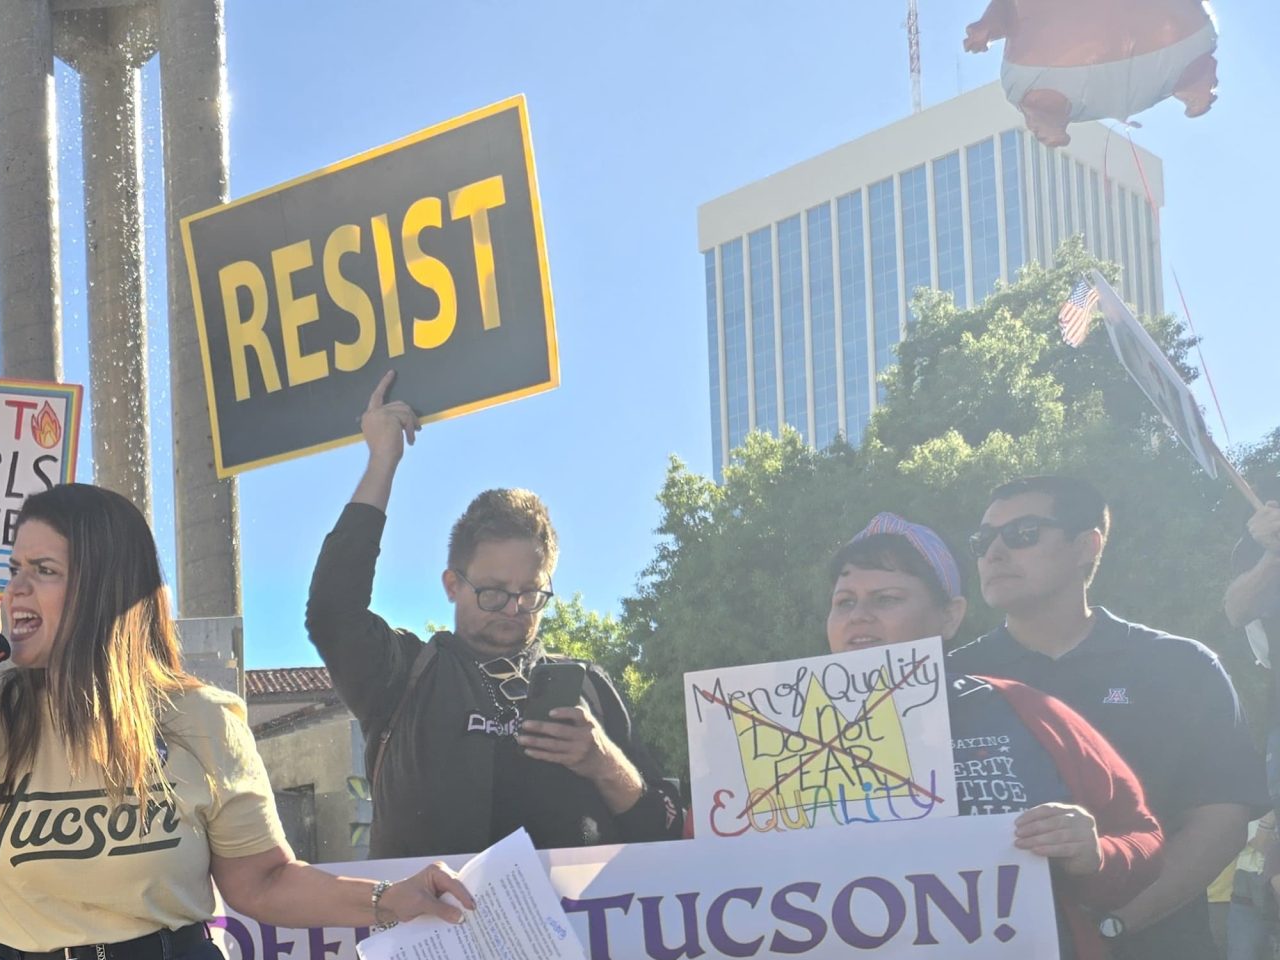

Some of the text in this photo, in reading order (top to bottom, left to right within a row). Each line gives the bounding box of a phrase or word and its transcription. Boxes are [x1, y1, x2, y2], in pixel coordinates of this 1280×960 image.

[218, 175, 506, 402] RESIST
[822, 648, 939, 717] Quality
[953, 756, 1017, 778] ERTY
[955, 779, 1026, 802] TICE
